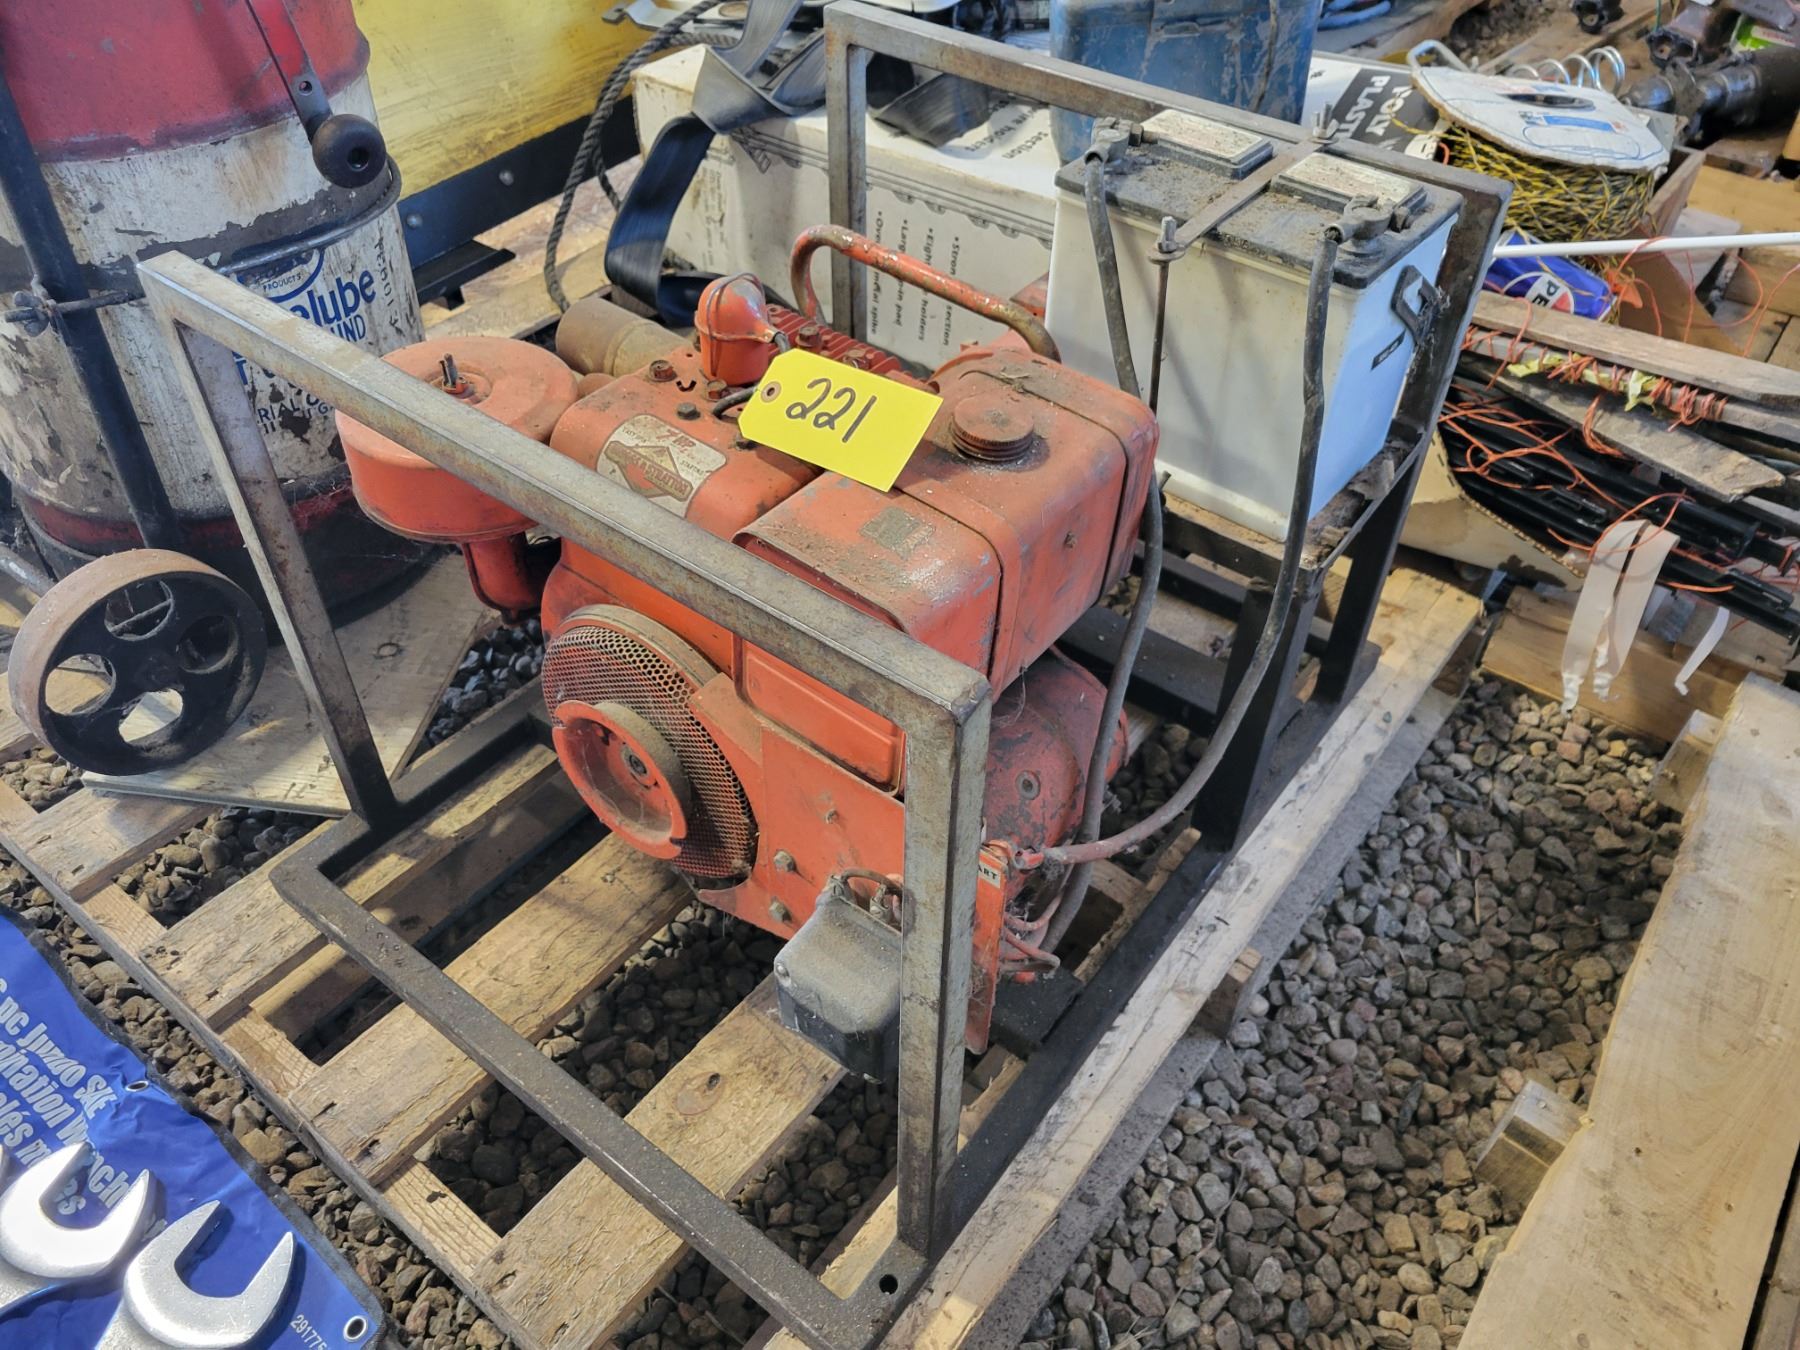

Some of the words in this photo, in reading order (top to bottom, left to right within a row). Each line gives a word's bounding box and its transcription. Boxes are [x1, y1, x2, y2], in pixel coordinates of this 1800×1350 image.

[1366, 85, 1414, 137] POLY
[1002, 131, 1049, 159] section
[949, 243, 960, 275] Stron
[262, 273, 302, 292] PRODUCTS
[918, 299, 928, 341] holders
[943, 304, 953, 346] section
[257, 398, 301, 424] RIAL
[786, 378, 877, 443] 221
